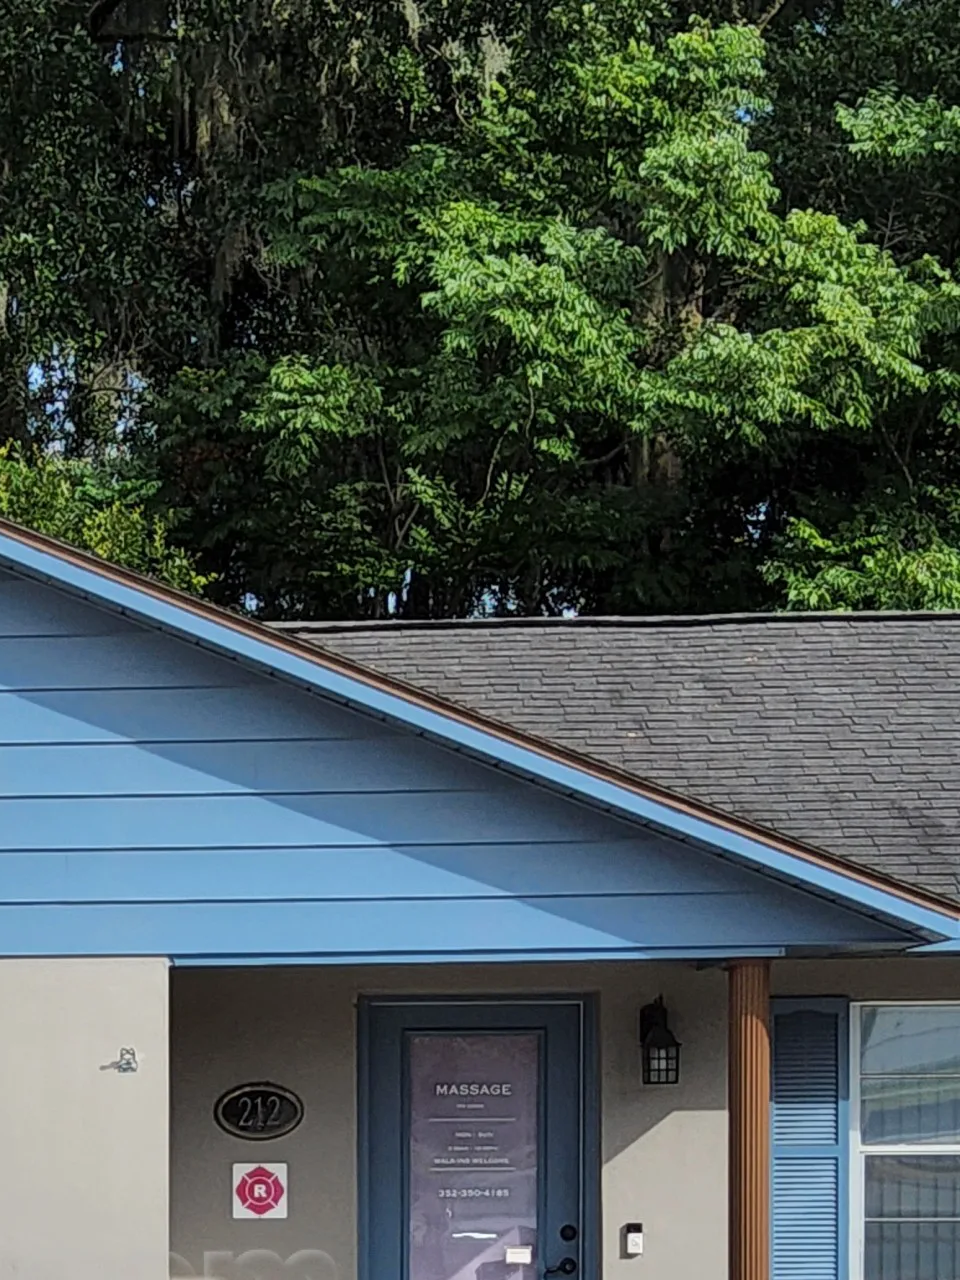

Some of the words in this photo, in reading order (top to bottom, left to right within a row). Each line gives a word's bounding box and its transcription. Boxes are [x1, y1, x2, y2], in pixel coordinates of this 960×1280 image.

[435, 1083, 513, 1097] MASSAGE
[238, 1095, 281, 1127] 212
[253, 1183, 268, 1199] R
